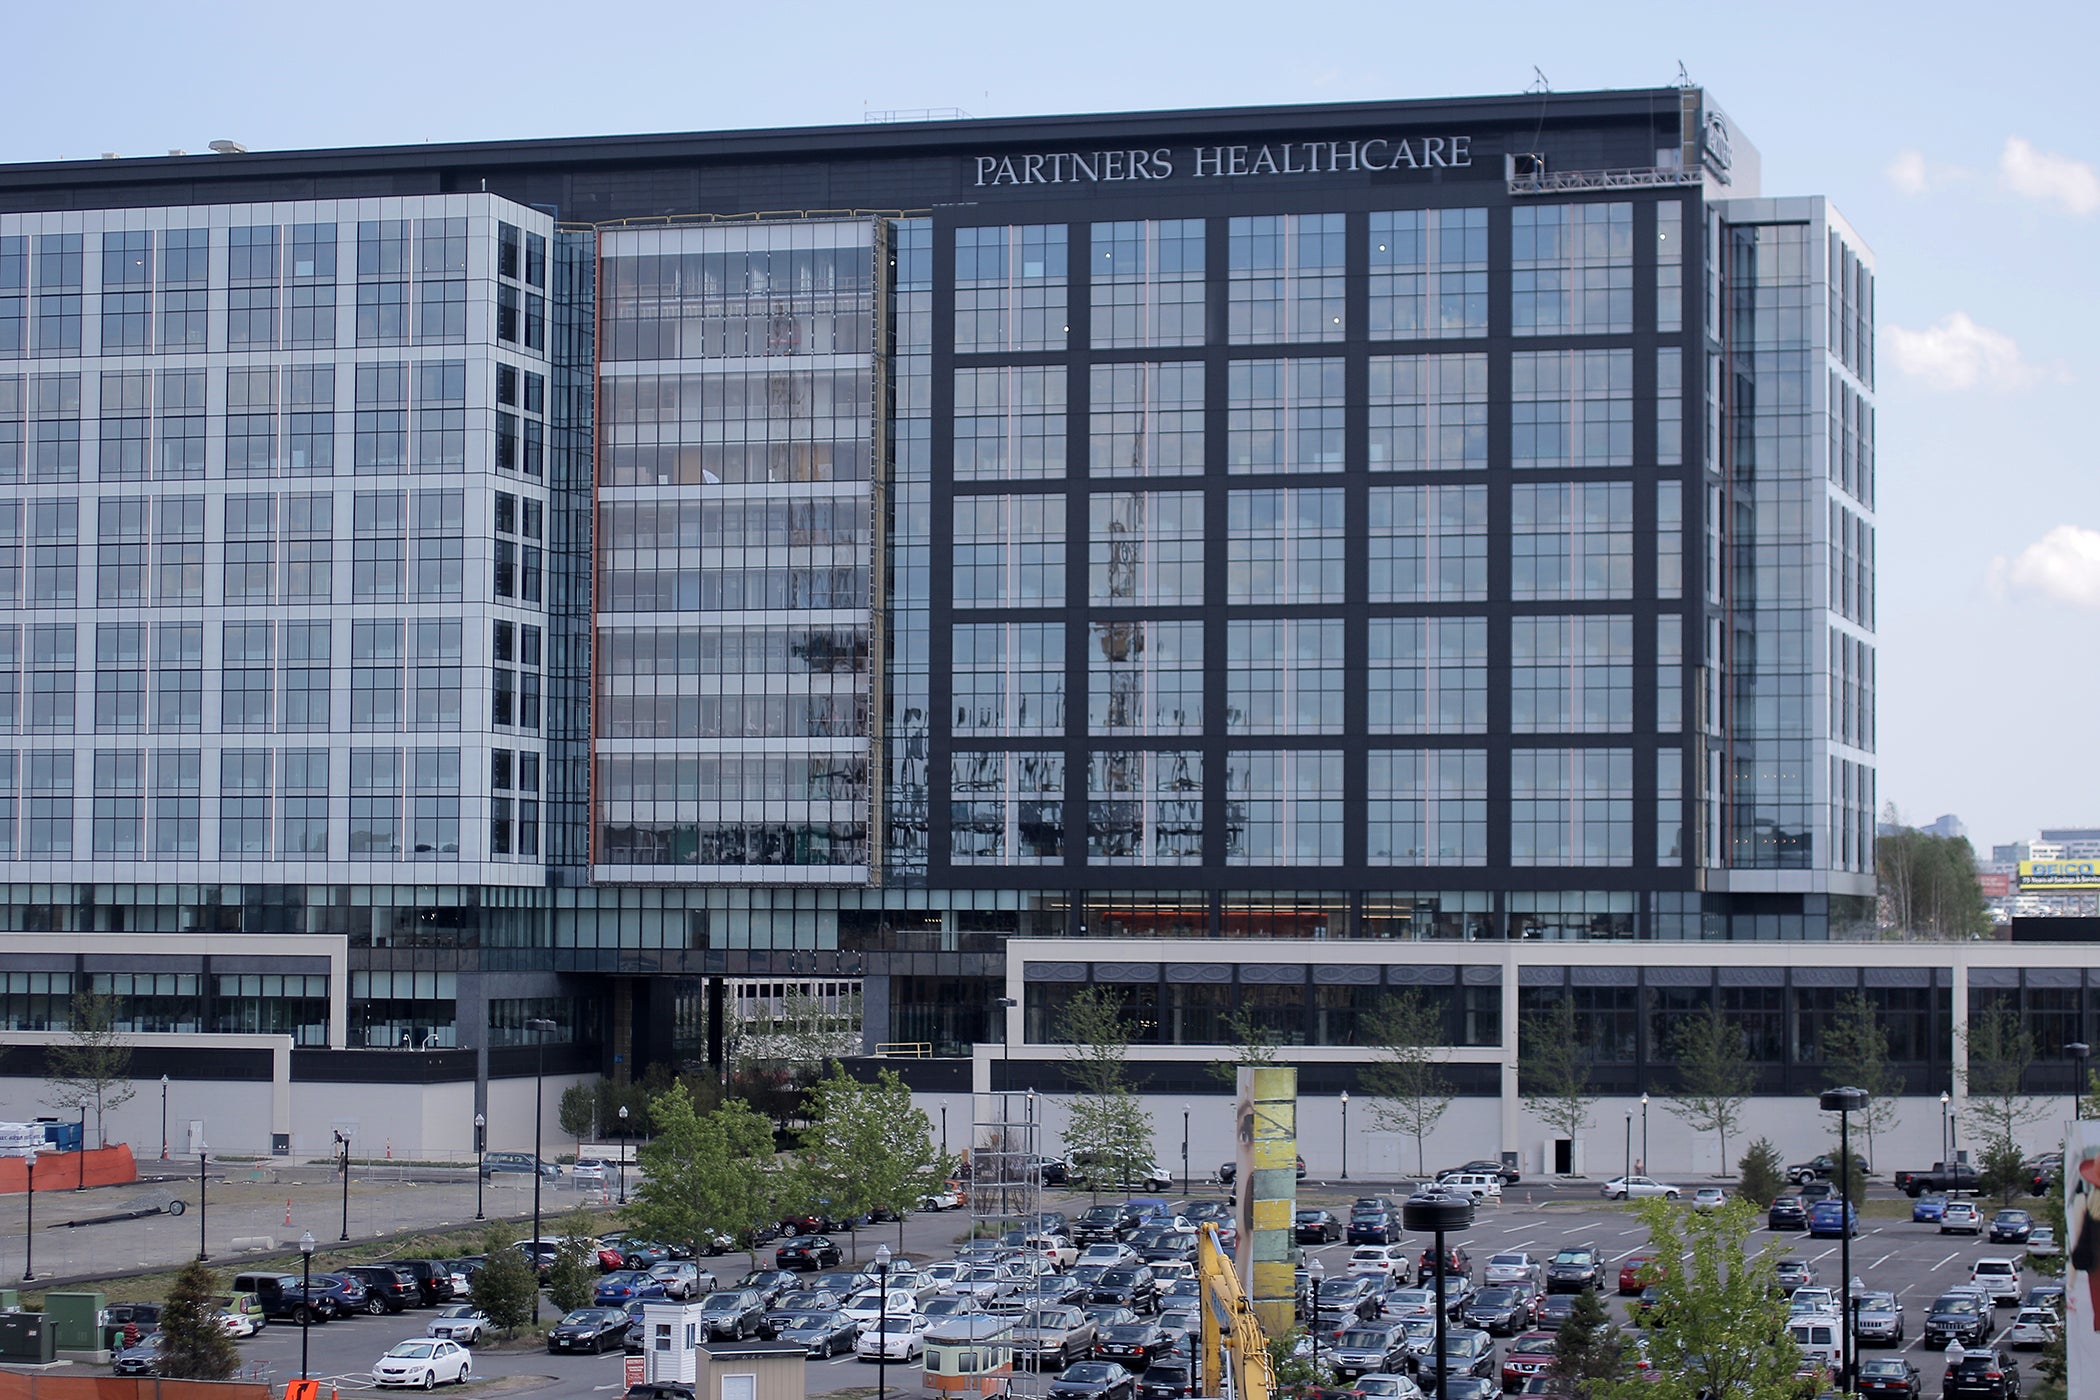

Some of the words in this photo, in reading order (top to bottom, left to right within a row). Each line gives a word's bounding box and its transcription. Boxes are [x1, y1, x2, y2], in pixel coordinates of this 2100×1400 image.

[974, 148, 1173, 186] PARTNERS
[1193, 135, 1473, 177] HEALTHCARE
[2032, 863, 2094, 877] GEICO
